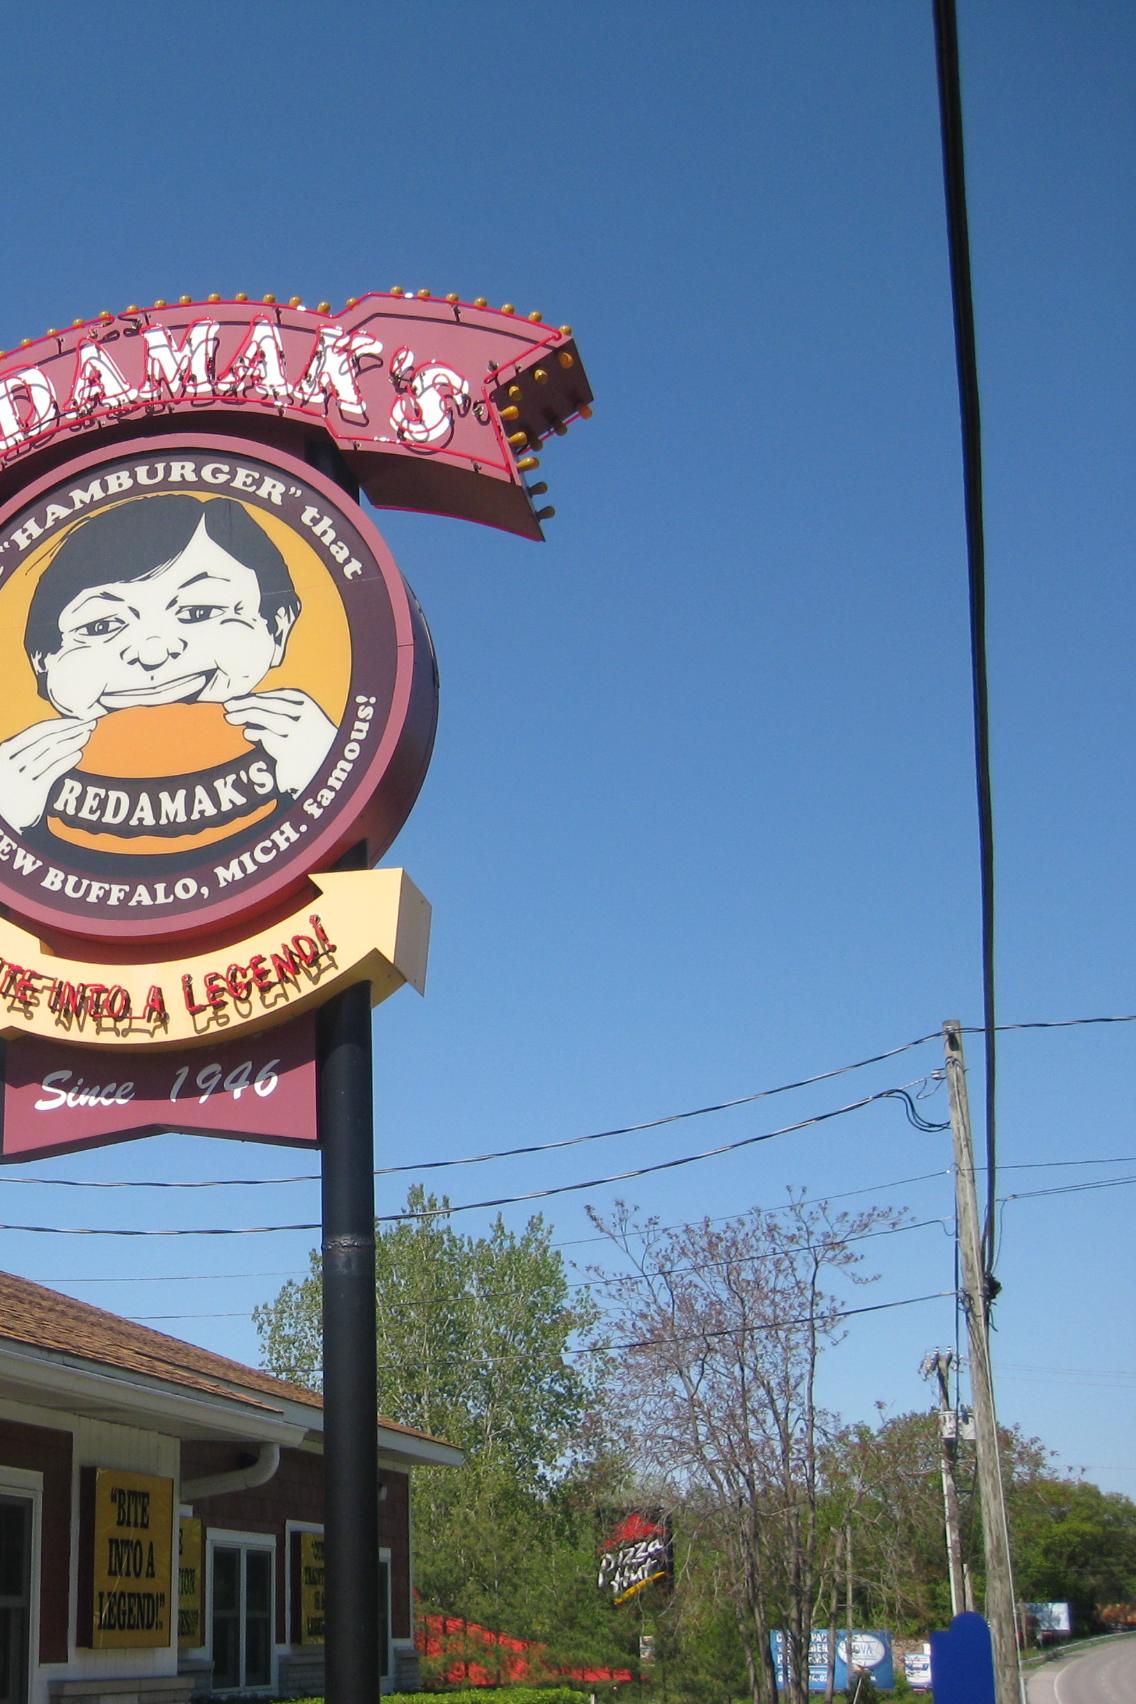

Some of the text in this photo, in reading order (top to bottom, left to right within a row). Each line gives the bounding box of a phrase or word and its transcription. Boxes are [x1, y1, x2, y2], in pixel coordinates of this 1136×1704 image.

[300, 505, 363, 580] that
[40, 866, 209, 906] BUFFALO,
[214, 821, 308, 888] MICH.
[302, 695, 377, 819] famous!
[53, 760, 274, 826] REDAMAK'S
[50, 979, 132, 1022] INTO
[144, 985, 169, 1026] A
[181, 914, 337, 1014] LEGEND!
[34, 1058, 281, 1111] Since 1946
[107, 1538, 143, 1578] INTO
[146, 1541, 156, 1578] A
